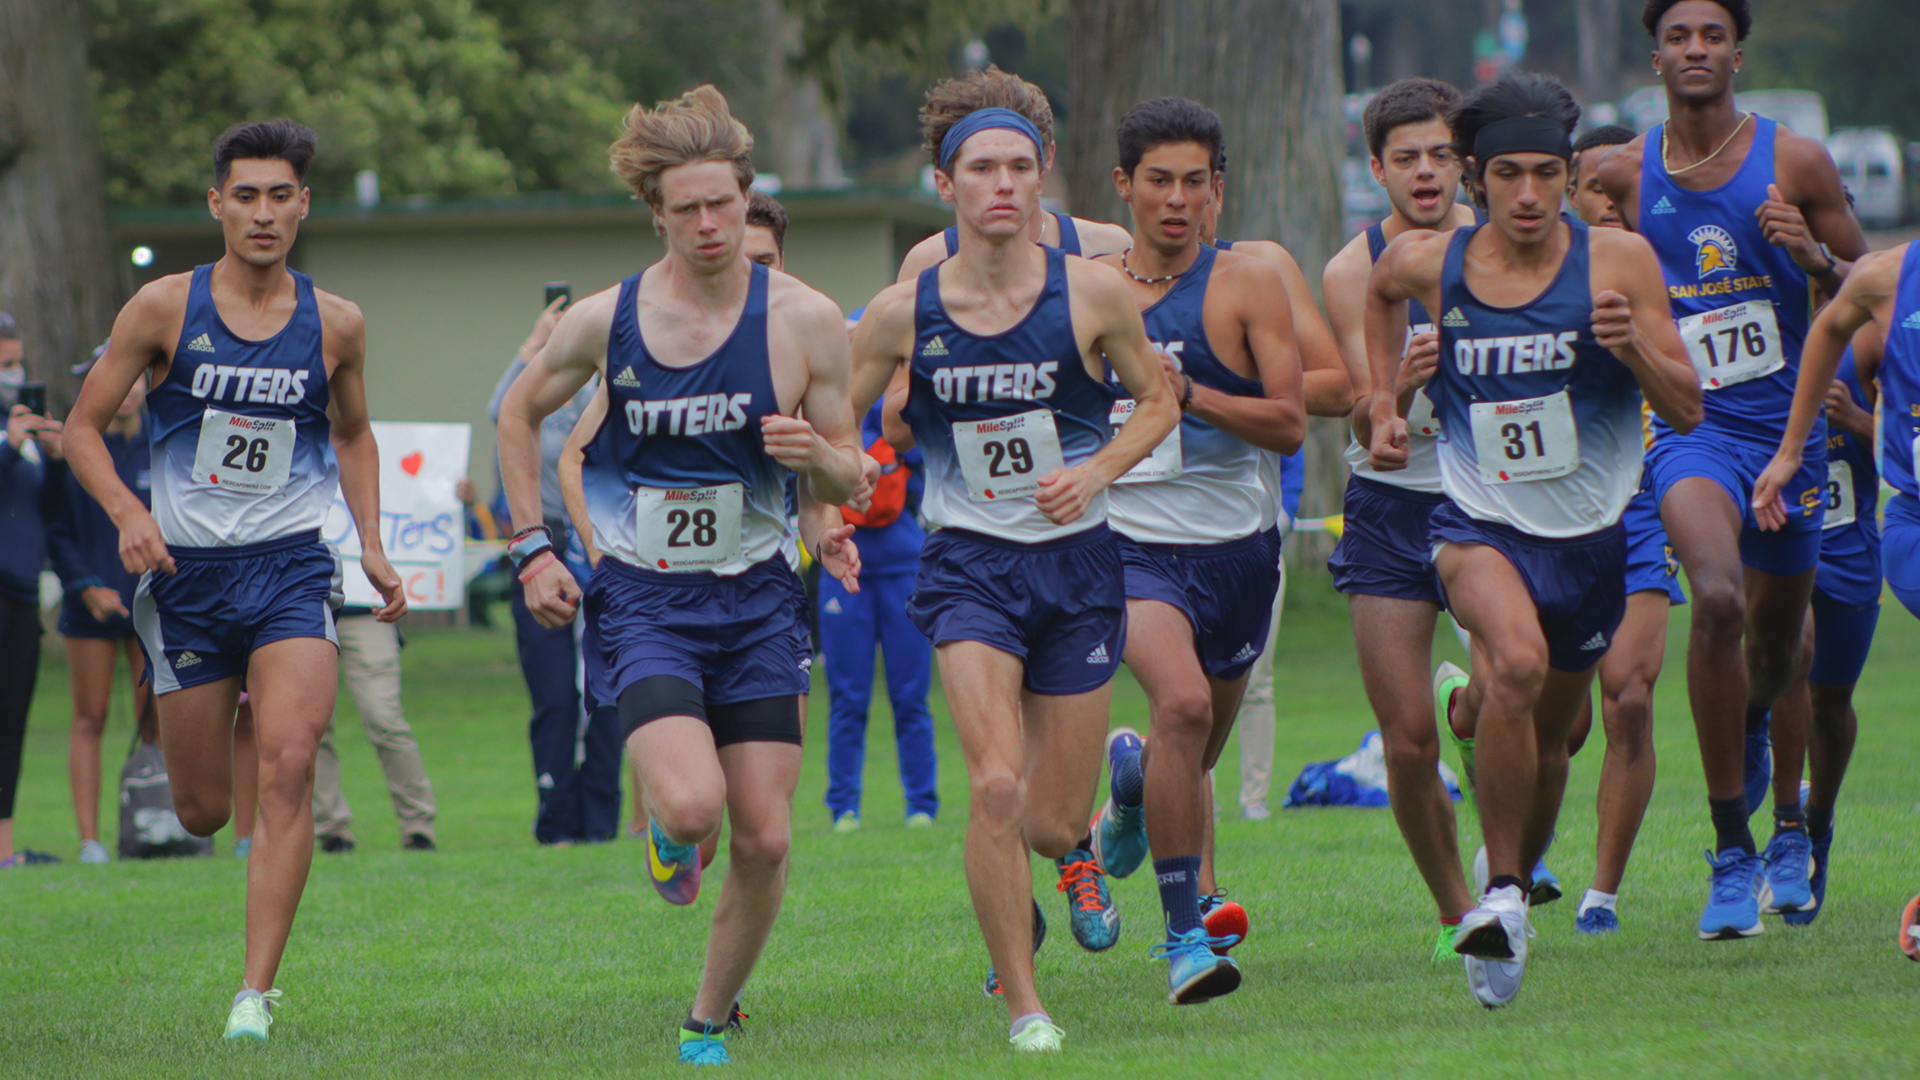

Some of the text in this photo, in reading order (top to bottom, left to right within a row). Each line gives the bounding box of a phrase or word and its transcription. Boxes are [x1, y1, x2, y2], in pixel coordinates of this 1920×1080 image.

[1651, 206, 1677, 215] adidas
[1669, 275, 1773, 299] SAN JOSÉ STATE
[1702, 305, 1747, 325] MileSplit
[187, 343, 216, 353] adidas
[922, 348, 950, 356] adidas
[1454, 330, 1578, 376] OTTERS
[1699, 321, 1767, 368] 176
[191, 362, 309, 405] OTTERS
[613, 378, 641, 388] adidas
[932, 360, 1058, 404] OTTERS
[625, 392, 752, 436] OTTERS
[1495, 399, 1545, 416] MileSplit
[228, 416, 276, 432] MileSplit
[976, 416, 1025, 434] MileSplit
[1501, 420, 1546, 460] 31
[1827, 434, 1845, 450] ATE
[221, 434, 269, 473] 26
[983, 437, 1034, 479] 29
[664, 489, 718, 502] MileSplit
[667, 508, 717, 548] 28
[1086, 655, 1110, 664] adidas
